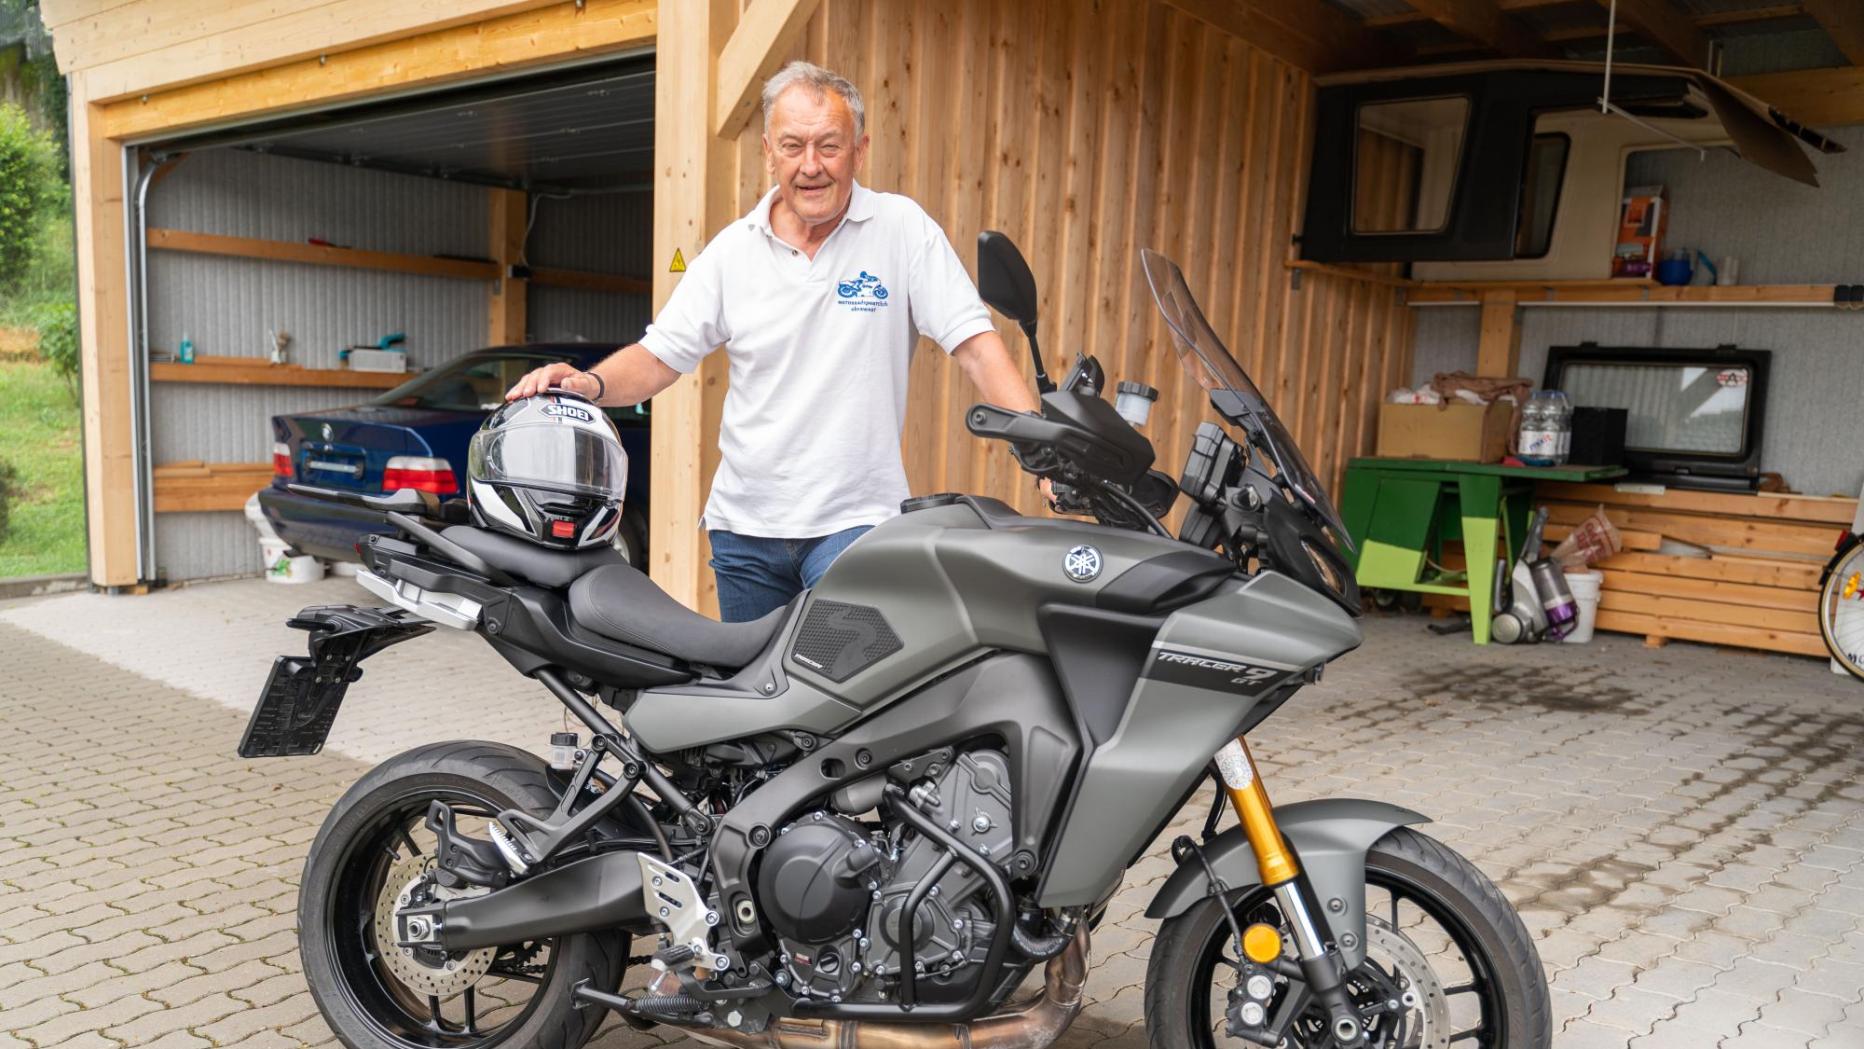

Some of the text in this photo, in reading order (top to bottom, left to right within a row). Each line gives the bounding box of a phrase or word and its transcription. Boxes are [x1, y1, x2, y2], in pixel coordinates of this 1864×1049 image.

[548, 404, 590, 421] SHOEI
[1158, 652, 1278, 680] TRACER 9
[1230, 677, 1262, 685] GT
